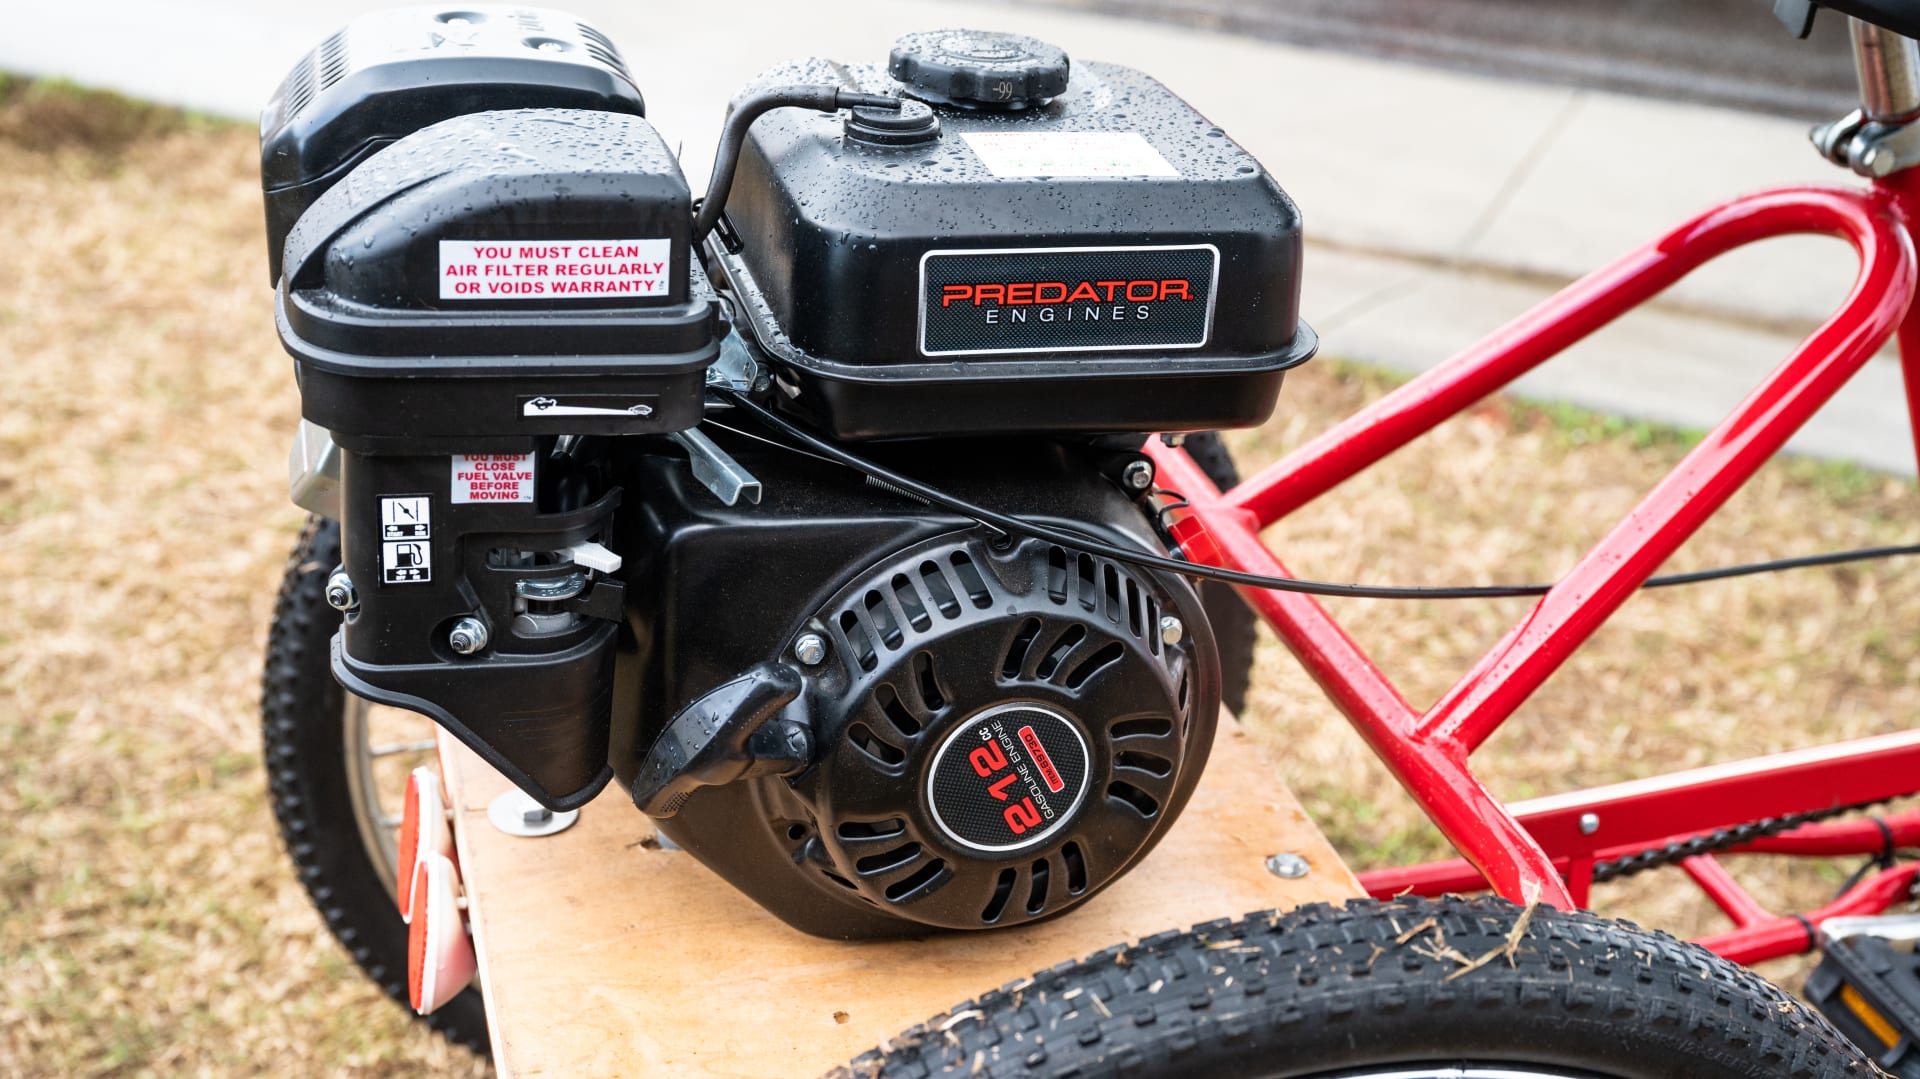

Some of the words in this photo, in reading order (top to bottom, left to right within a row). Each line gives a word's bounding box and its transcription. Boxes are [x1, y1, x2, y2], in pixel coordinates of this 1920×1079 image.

[474, 247, 512, 259] YOU
[519, 246, 572, 258] MUST
[578, 246, 639, 258] CLEAN
[446, 264, 478, 276] AIR
[484, 264, 549, 276] FILTER
[555, 262, 665, 275] REGULARLY
[454, 282, 481, 294] OR
[488, 282, 545, 294] VOIDS
[551, 280, 656, 293] WARRANTY
[986, 305, 1150, 324] ENGINES
[475, 462, 516, 471] CLOSE
[457, 472, 489, 481] FUEL
[493, 472, 532, 481] VALVE
[470, 482, 519, 490] BEFORE
[470, 491, 519, 500] MOVING
[991, 720, 1021, 763] ENGINE
[1025, 734, 1048, 769] 69730
[969, 739, 1042, 834] 212
[1016, 763, 1054, 819] GASOLINE
